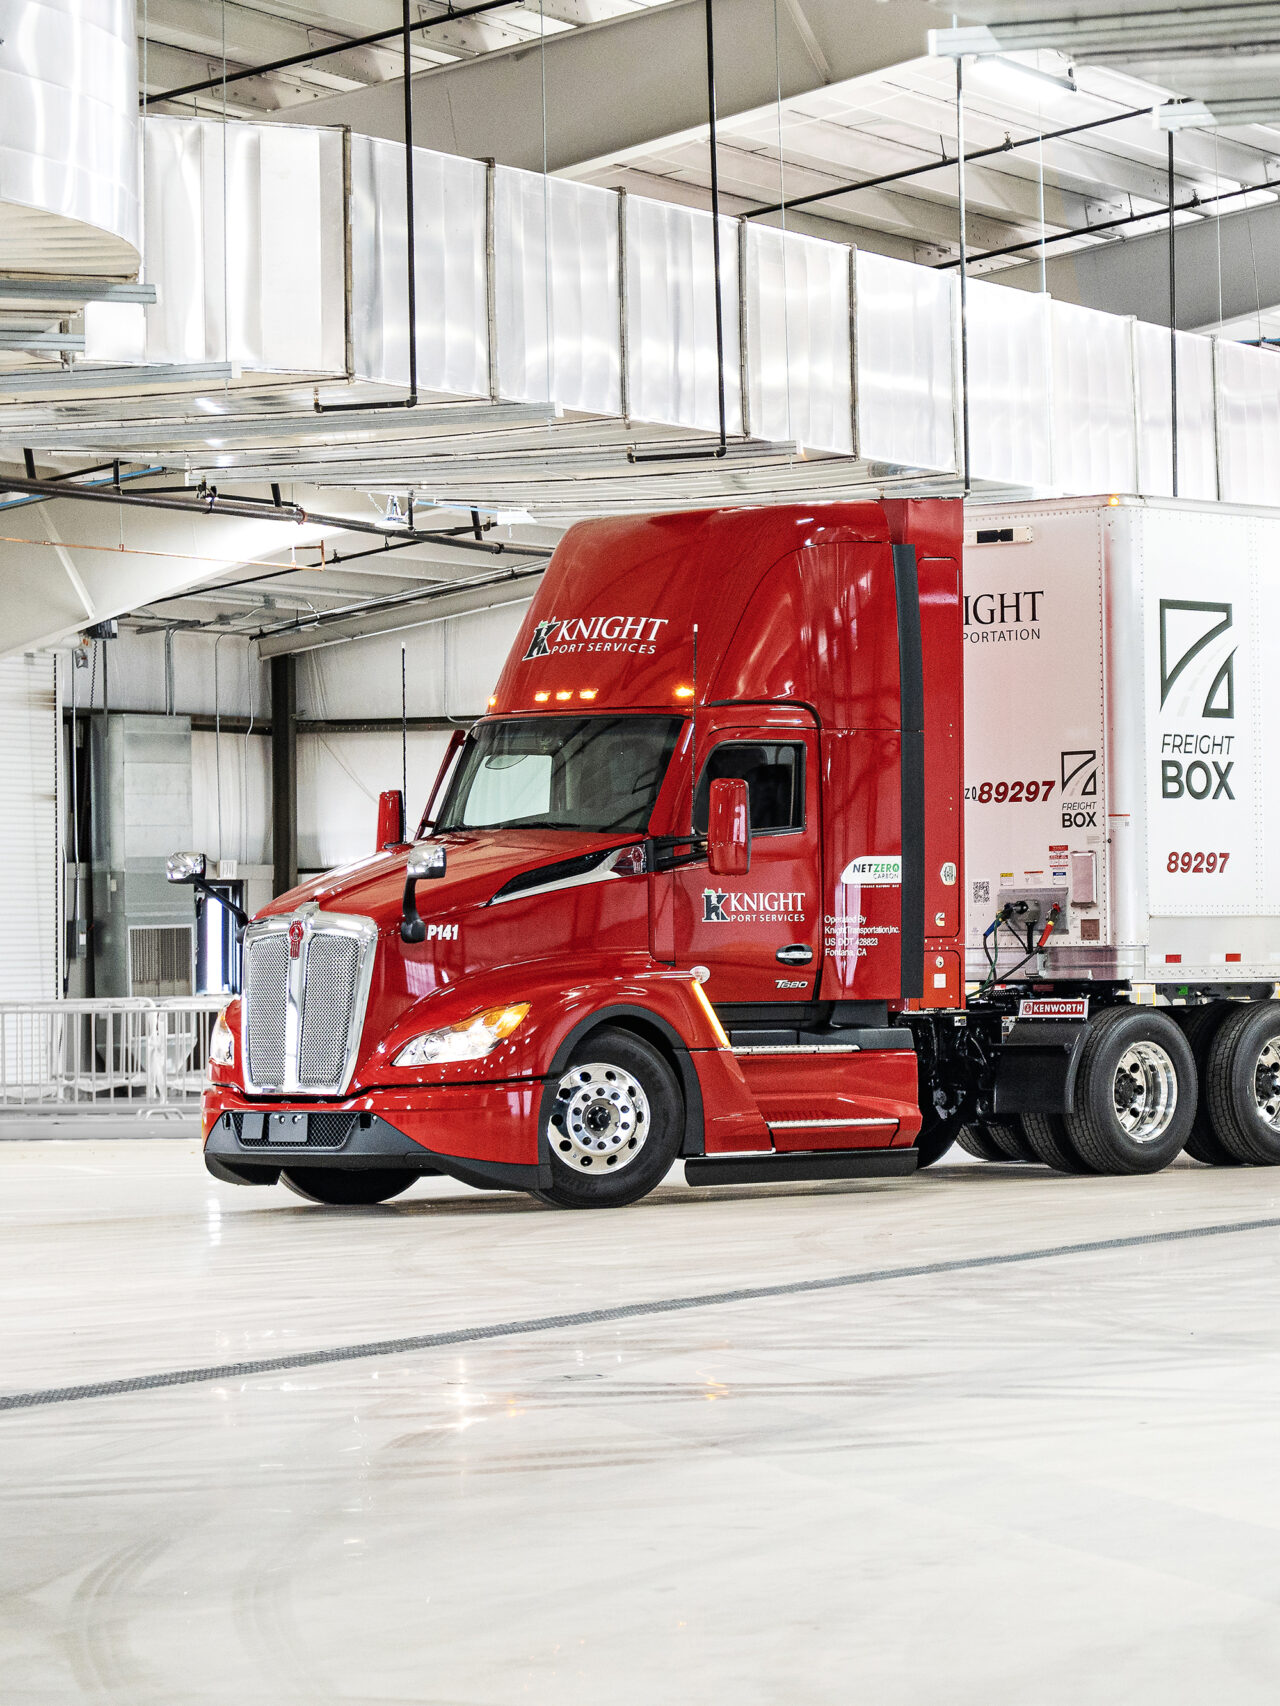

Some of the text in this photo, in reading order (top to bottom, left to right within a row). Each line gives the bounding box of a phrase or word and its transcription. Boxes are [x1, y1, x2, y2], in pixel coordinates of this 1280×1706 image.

[555, 616, 669, 642] KNIGHT
[551, 642, 656, 655] PORT SERVICES
[1161, 733, 1235, 755] FREIGHT
[1161, 759, 1236, 801] BOX
[978, 780, 1056, 804] 89297
[1062, 801, 1097, 811] FREIGHT
[1062, 811, 1097, 828] BOX
[1166, 851, 1230, 874] 89297
[730, 892, 806, 912] KNIGHT
[731, 914, 806, 922] PORT SERVICES
[858, 914, 867, 925] By
[427, 924, 459, 941] P141
[824, 938, 836, 947] US
[838, 938, 854, 947] DOT
[857, 948, 867, 957] CA
[774, 979, 809, 989] T680
[1033, 1003, 1083, 1013] KENWORTH
